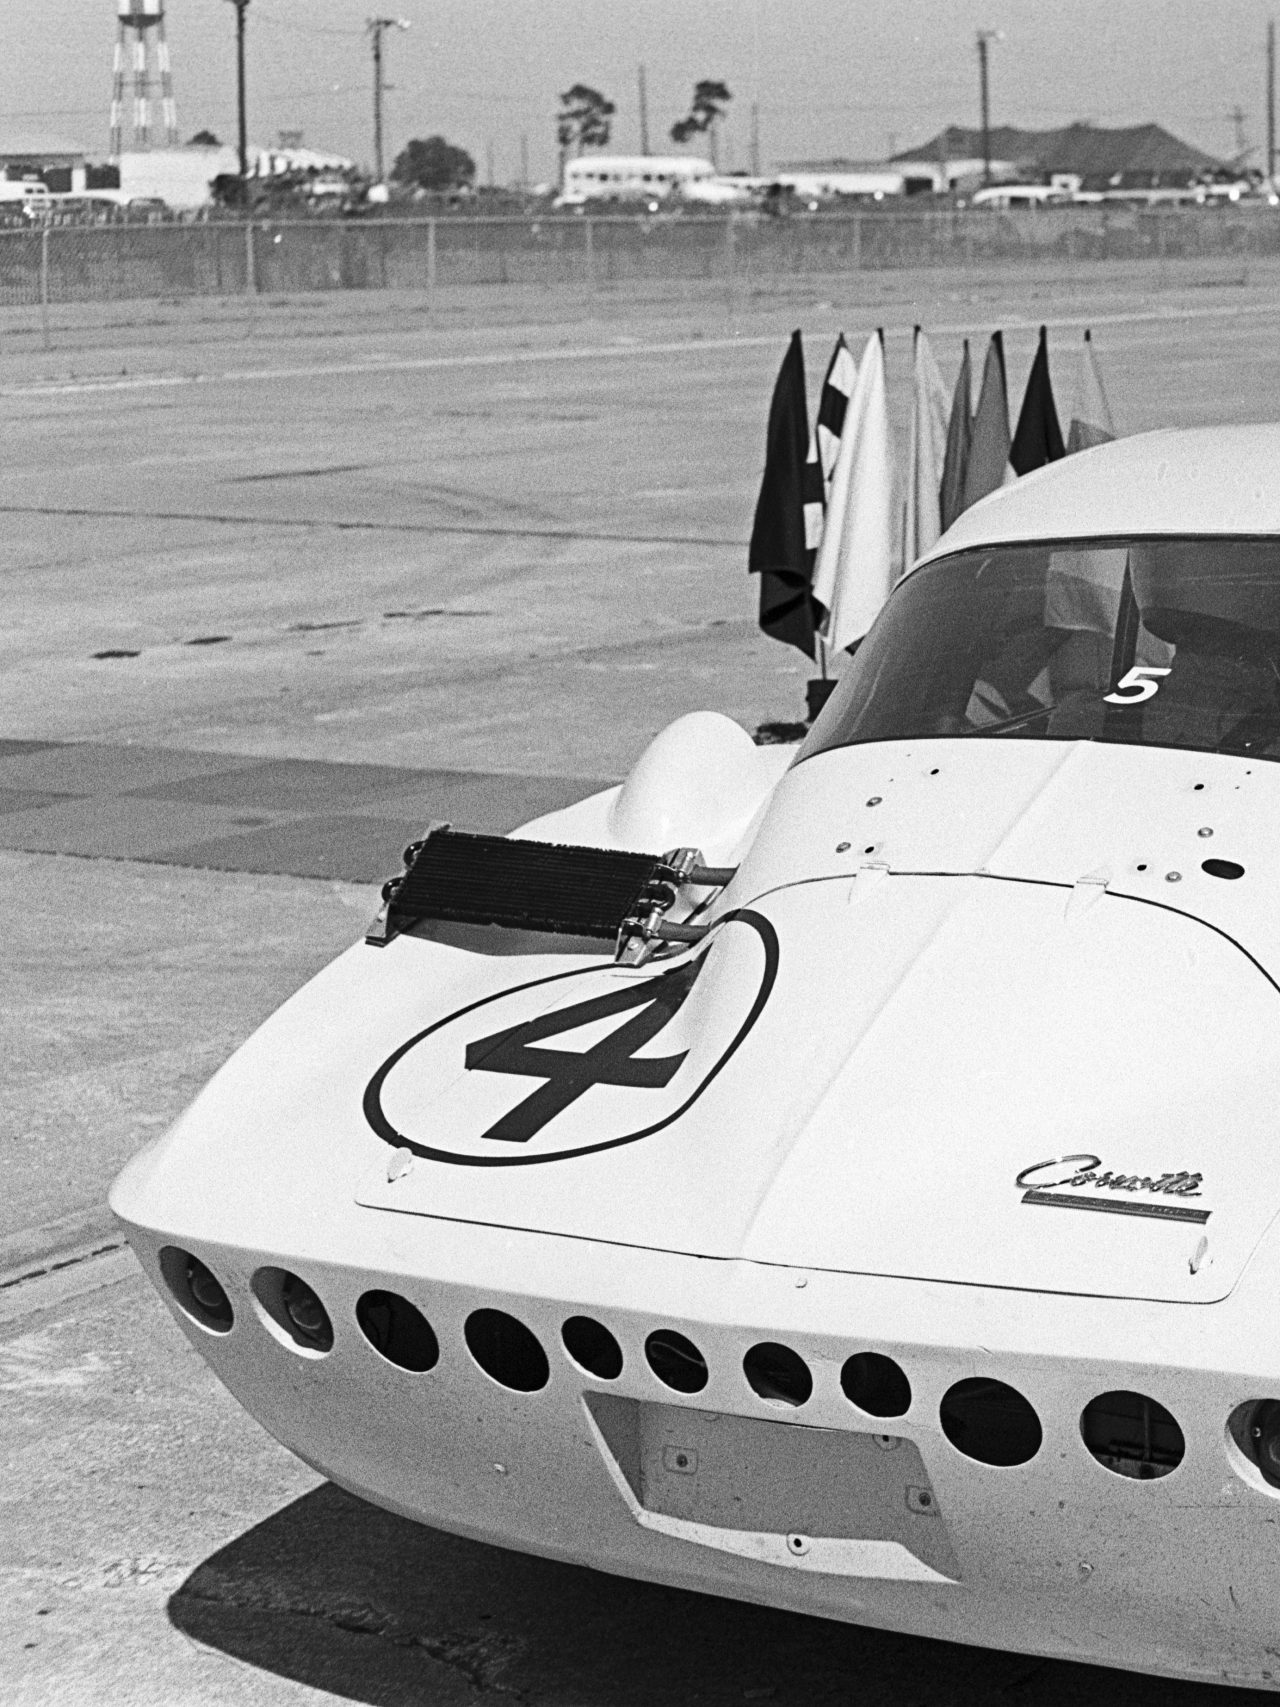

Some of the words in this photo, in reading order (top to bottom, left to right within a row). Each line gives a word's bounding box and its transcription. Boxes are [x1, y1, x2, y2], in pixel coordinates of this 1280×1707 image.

[1103, 666, 1172, 704] 5
[465, 942, 713, 1142] 4
[1016, 1154, 1203, 1196] Corvette
